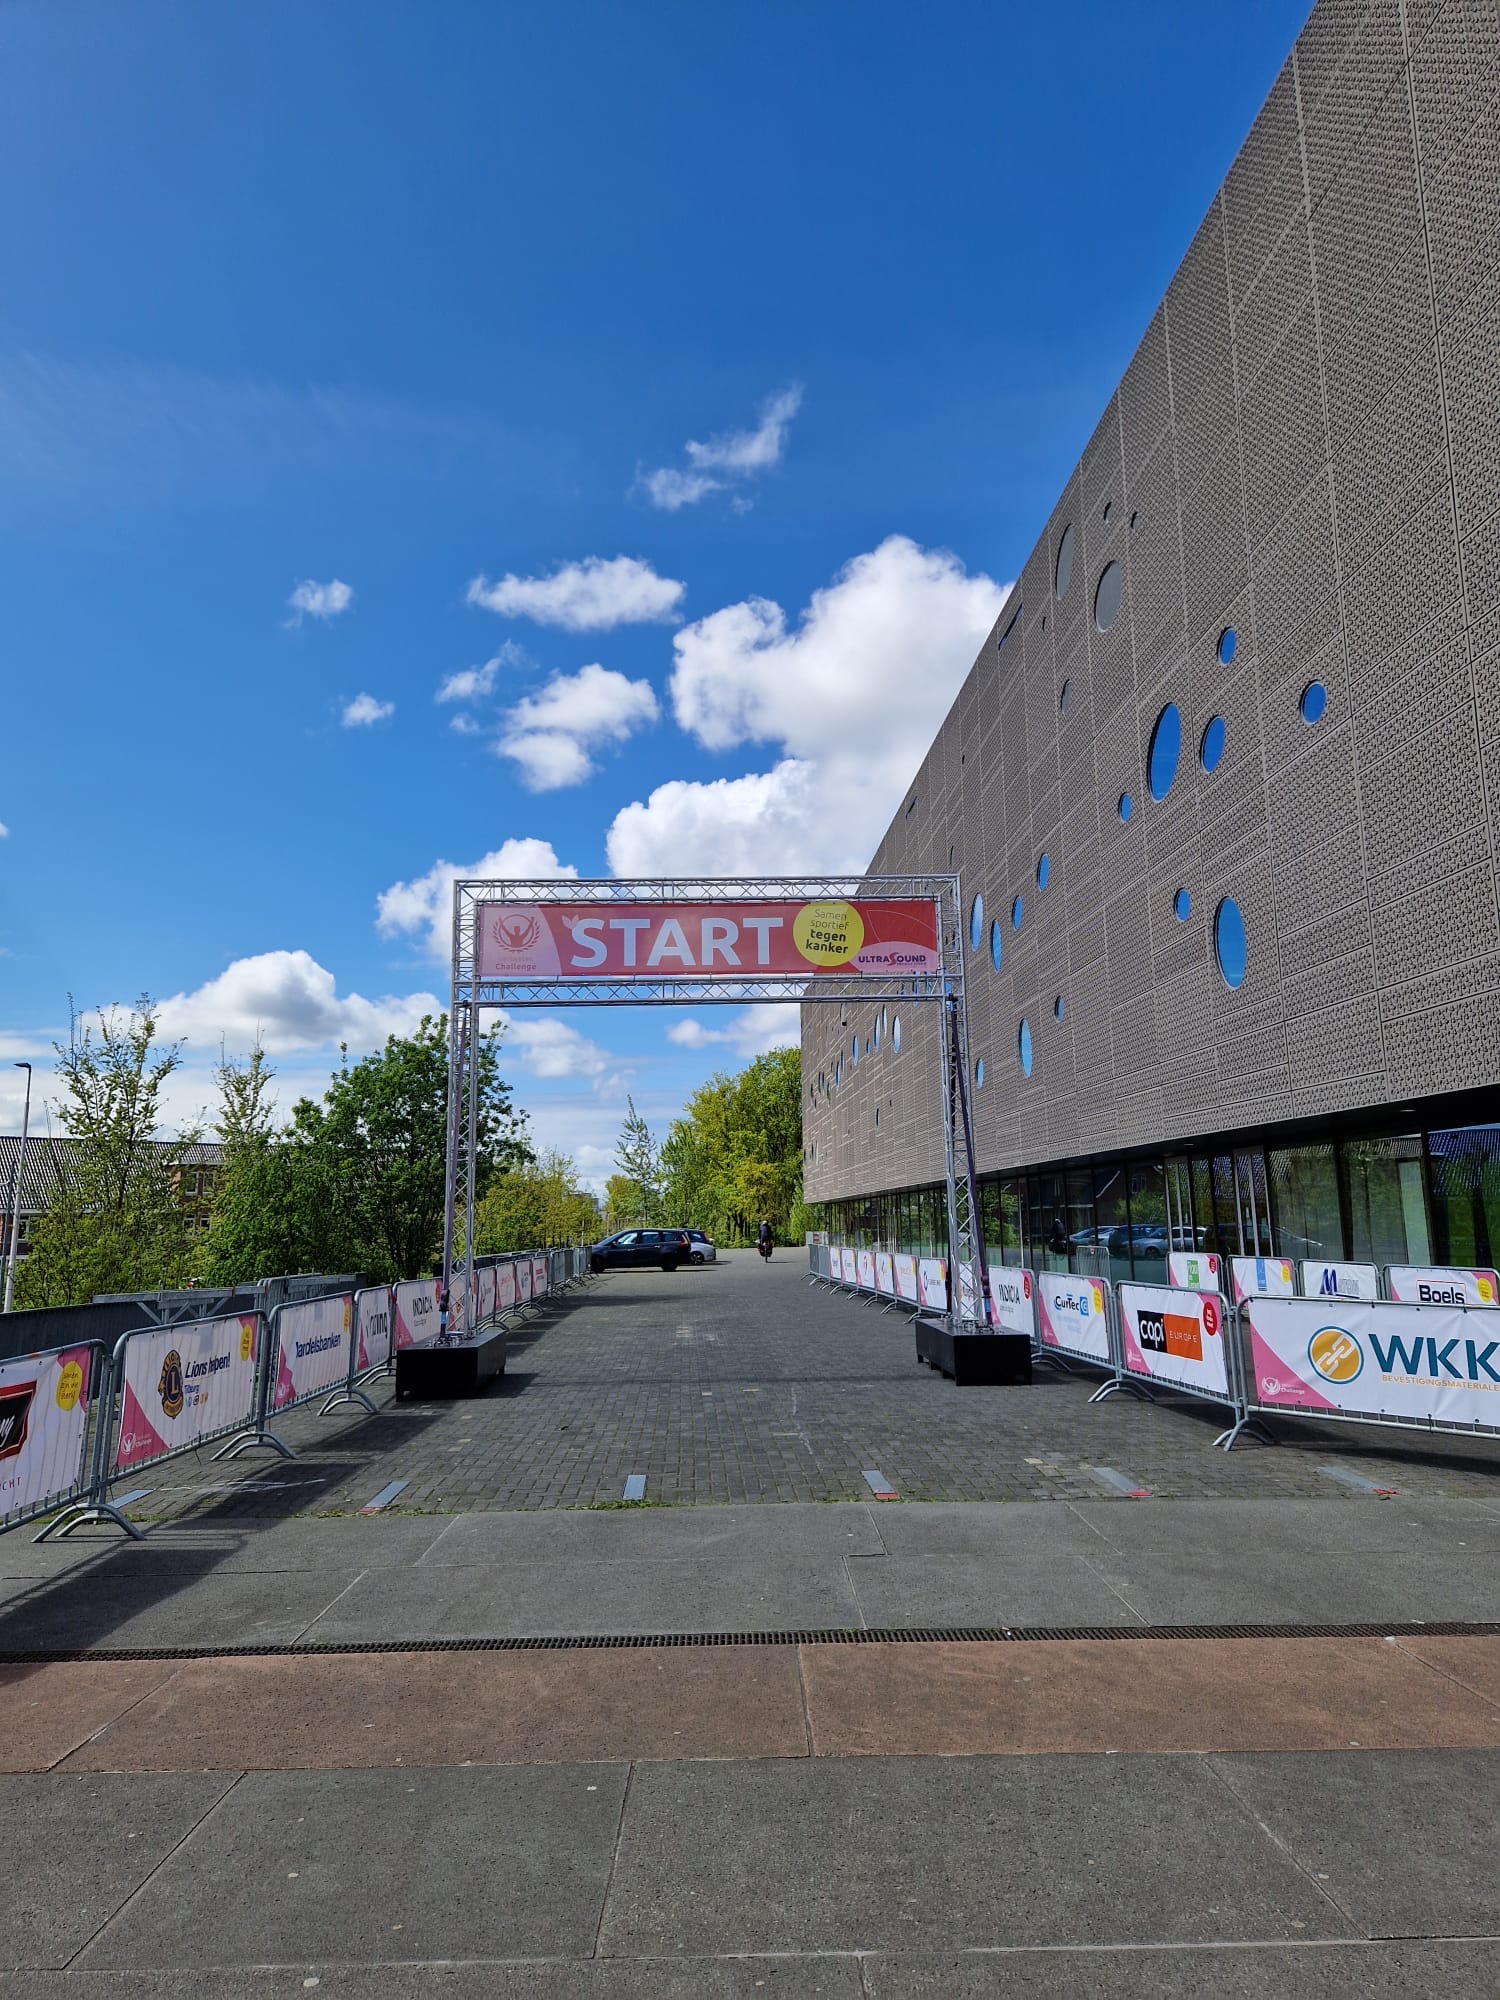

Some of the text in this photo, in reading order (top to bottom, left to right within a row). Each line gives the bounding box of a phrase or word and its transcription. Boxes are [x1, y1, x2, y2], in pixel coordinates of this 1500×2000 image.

[814, 909, 847, 921] Samen
[810, 920, 849, 930] sportief
[570, 917, 783, 968] START
[810, 929, 847, 942] tegen
[806, 939, 849, 954] kanker
[858, 952, 926, 966] ULTRASOUND
[495, 963, 536, 971] Challenge
[1418, 1284, 1465, 1304] Boels
[1055, 1294, 1080, 1311] CurTec
[1140, 1318, 1165, 1349] copi
[1169, 1330, 1198, 1343] EUROPE
[1368, 1333, 1500, 1382] WKK
[184, 1360, 208, 1379] Lions
